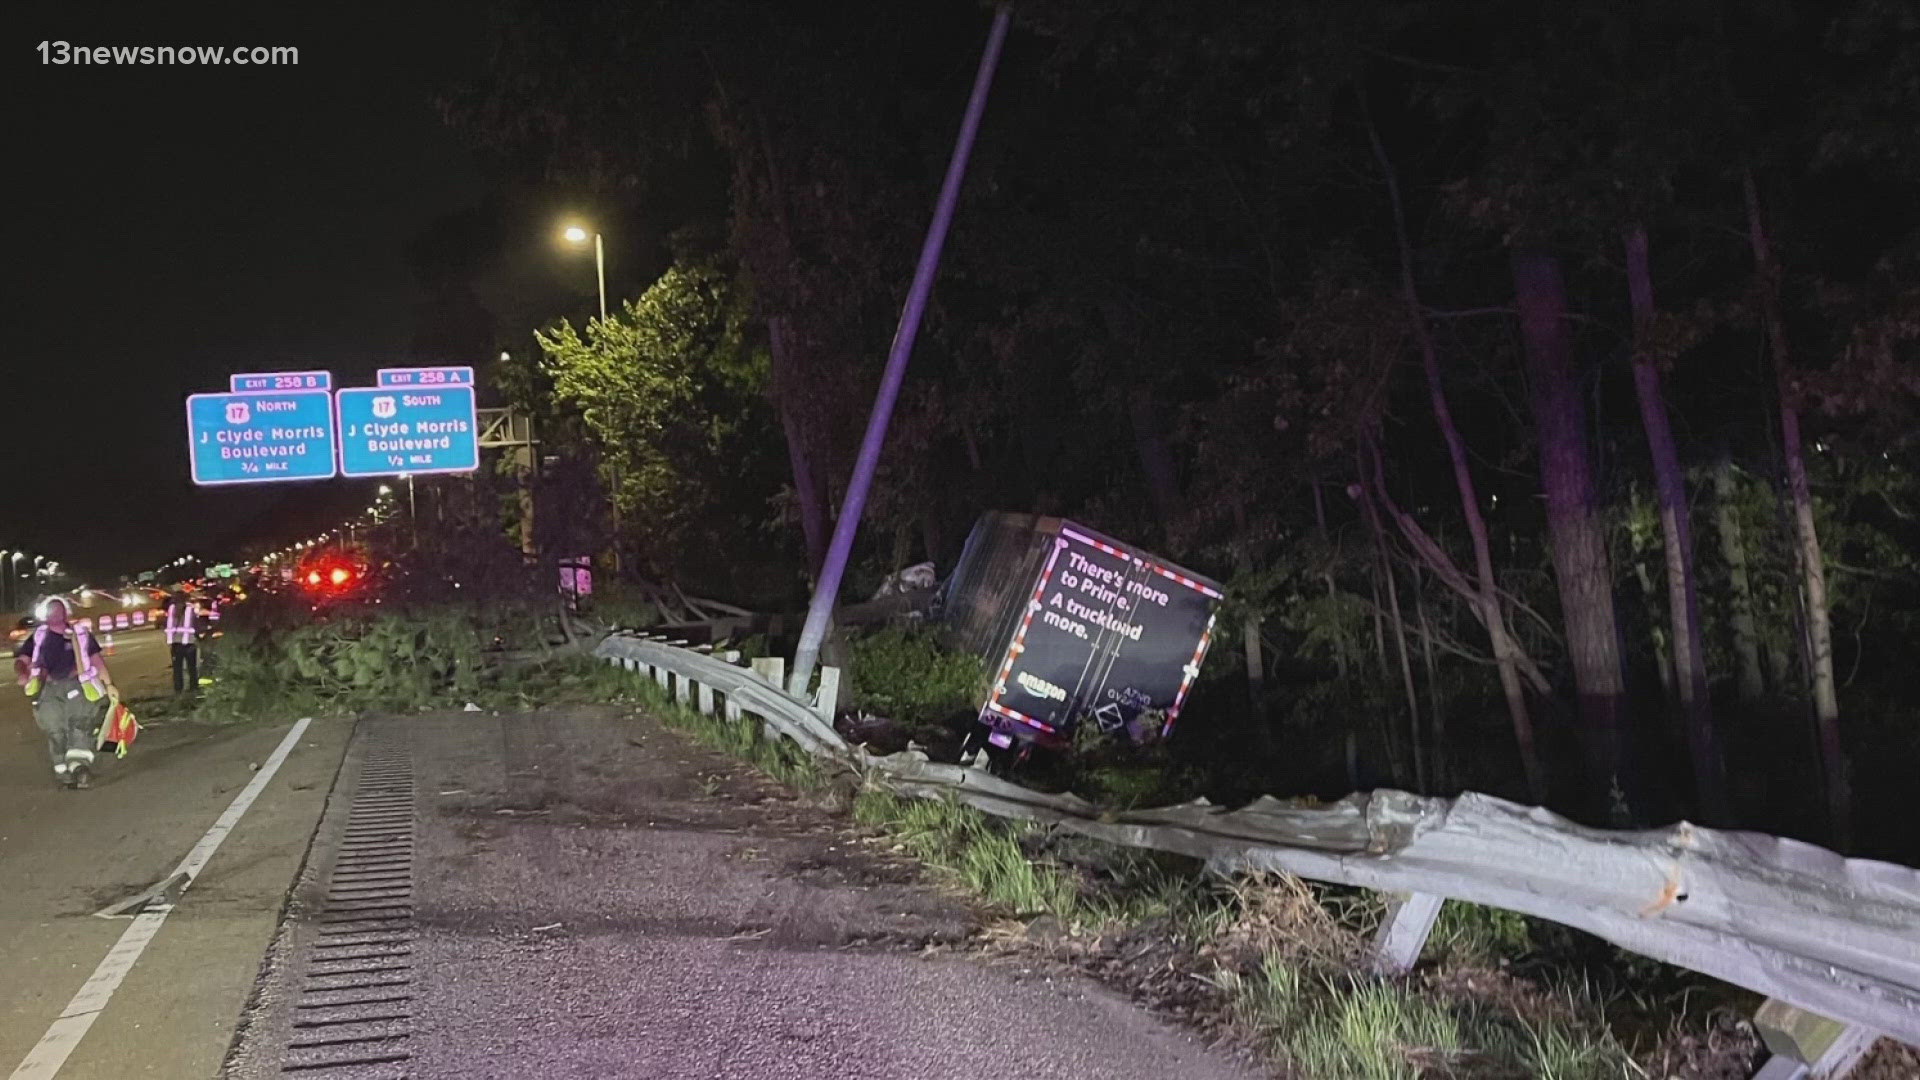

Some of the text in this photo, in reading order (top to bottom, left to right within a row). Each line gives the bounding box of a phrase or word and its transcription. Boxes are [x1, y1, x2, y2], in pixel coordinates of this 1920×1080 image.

[245, 376, 317, 388] EXIT 258 B
[391, 371, 461, 383] EXIT 258 A
[231, 407, 244, 419] 17
[378, 401, 391, 413] 17
[200, 426, 325, 444] J Clyde Morris
[348, 420, 468, 438] J Clyde Morris
[221, 442, 306, 459] Boulevard
[368, 435, 450, 452] Boulevard
[241, 462, 289, 473] 3/4 MILE
[388, 454, 433, 466] 1/2 MILE
[1069, 551, 1169, 607] There's more
[1060, 570, 1131, 611] to Prime.
[1050, 592, 1144, 641] A truckload
[1043, 611, 1088, 640] more.
[1017, 671, 1067, 702] amazon
